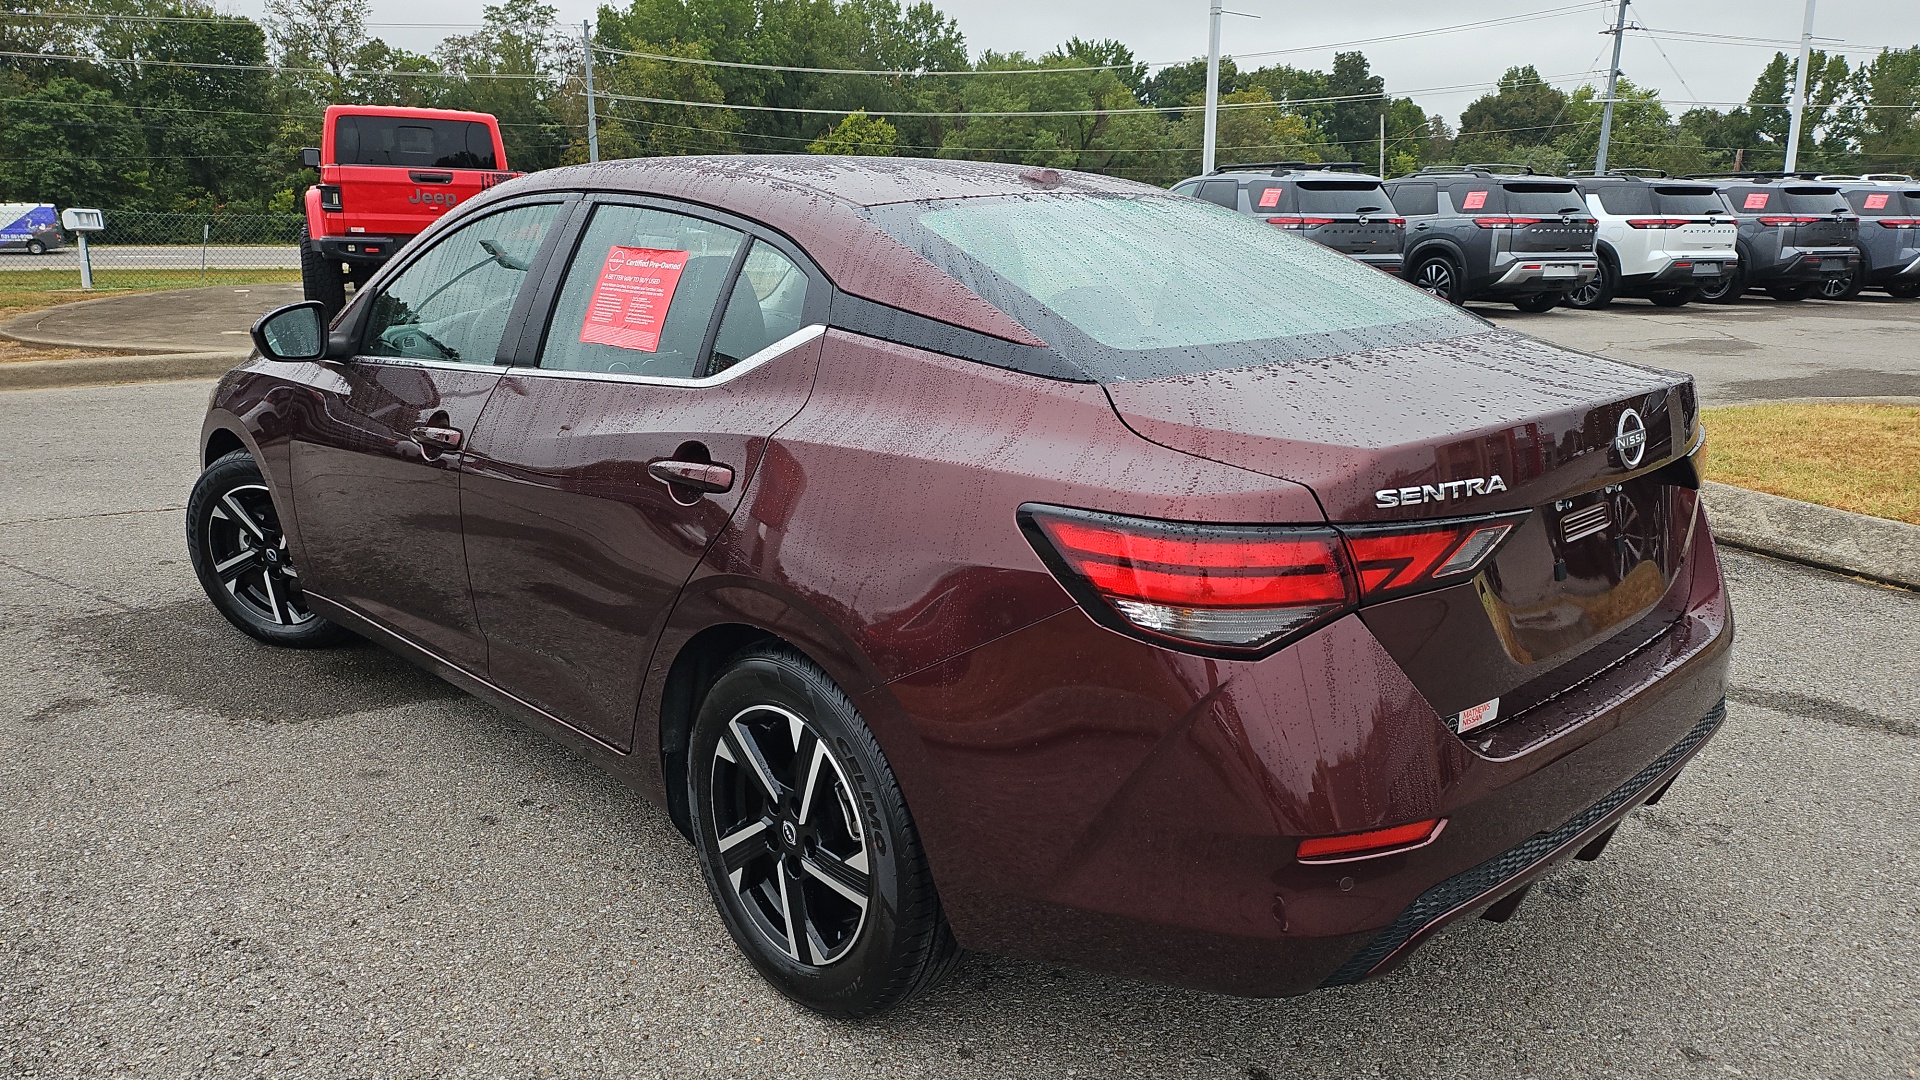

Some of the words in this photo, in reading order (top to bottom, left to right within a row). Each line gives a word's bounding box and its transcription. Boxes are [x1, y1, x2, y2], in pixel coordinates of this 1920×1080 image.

[409, 189, 456, 207] Jeep
[626, 259, 649, 267] Certified
[650, 261, 682, 270] Pre-Owned
[1618, 433, 1645, 448] NISSA
[1375, 475, 1507, 509] SENTRA
[189, 470, 221, 549] IRONMAN
[1463, 703, 1490, 718] MATHEWS
[1462, 714, 1482, 726] NISSAN
[837, 737, 886, 856] CELIMO
